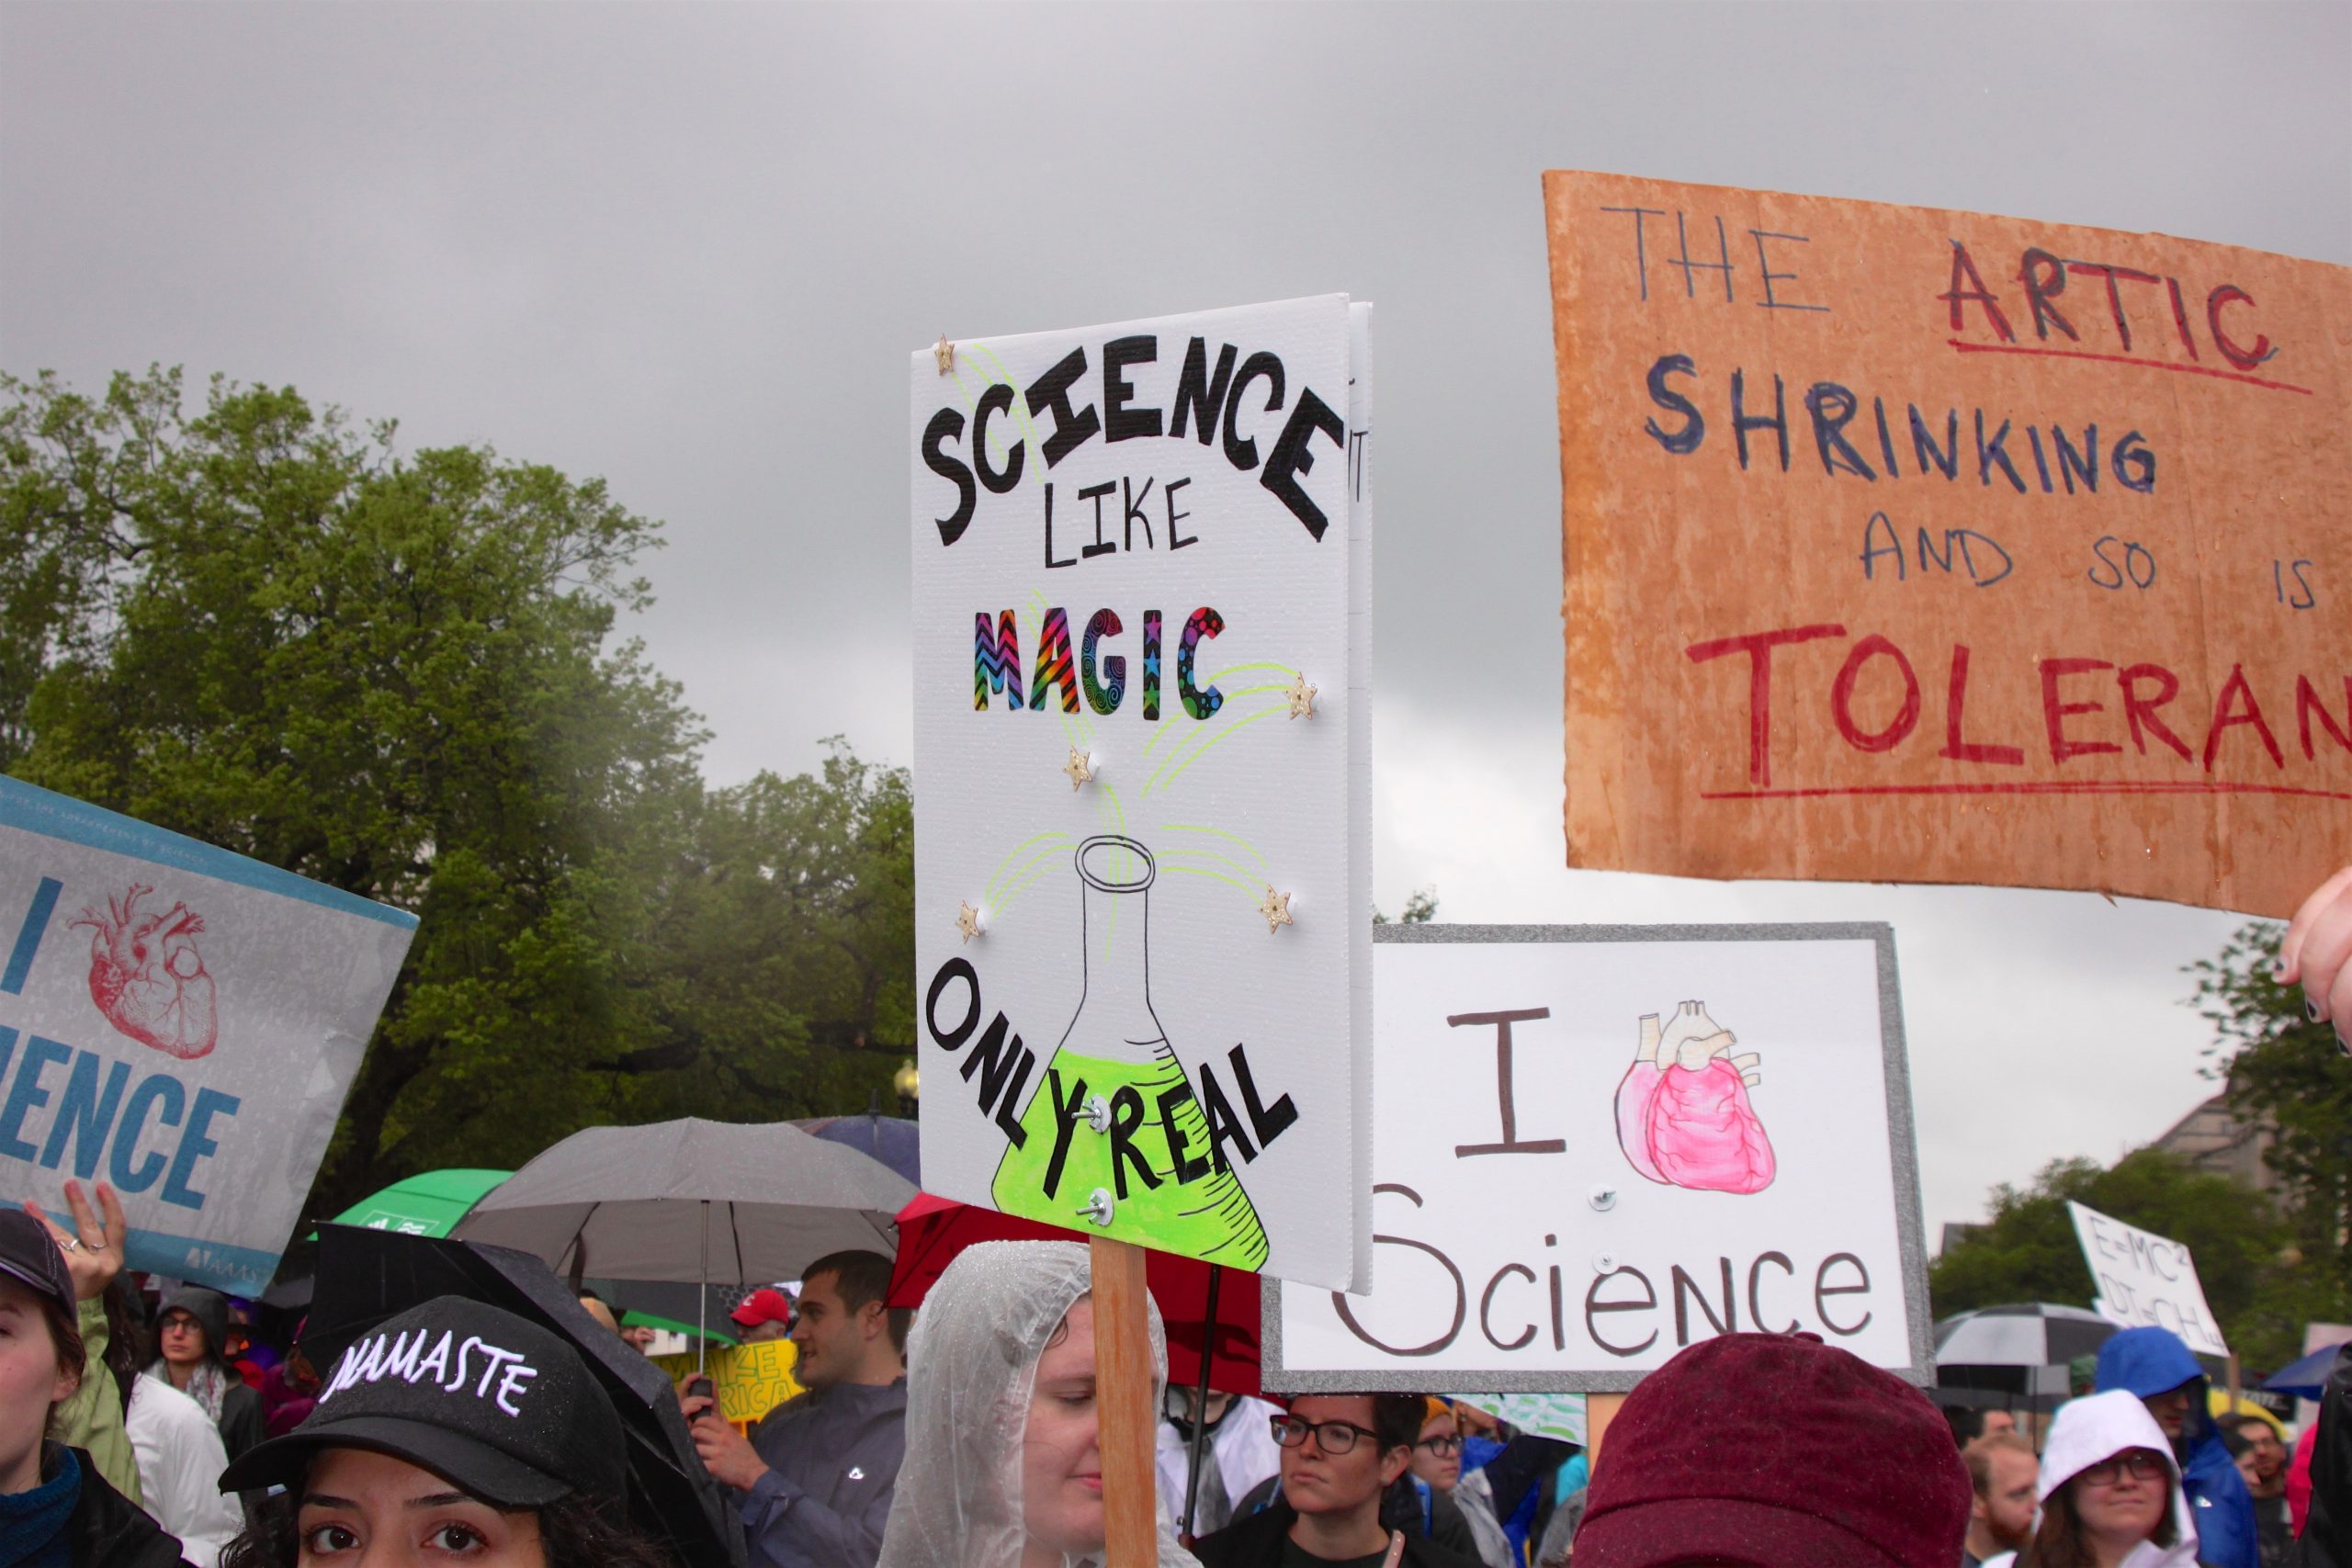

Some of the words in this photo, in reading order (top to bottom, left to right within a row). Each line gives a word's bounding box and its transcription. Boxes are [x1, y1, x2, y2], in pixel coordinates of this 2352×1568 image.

[1600, 205, 1832, 312] THE
[1938, 238, 2280, 370] ARTIC
[922, 334, 1345, 547] SCIENCE
[1645, 354, 2156, 494] SHRINKING
[1044, 476, 1200, 569] LIKE
[1860, 511, 2013, 587] AND
[2087, 536, 2156, 589] SO
[2274, 559, 2315, 609] IS
[974, 606, 1226, 721] MAGIC
[0, 876, 64, 996] I
[0, 1024, 242, 1211] ENCE
[925, 956, 1089, 1201] ONLY
[1110, 1043, 1299, 1201] REAL
[1446, 1007, 1566, 1159] I
[318, 1328, 538, 1418] NAMASTE
